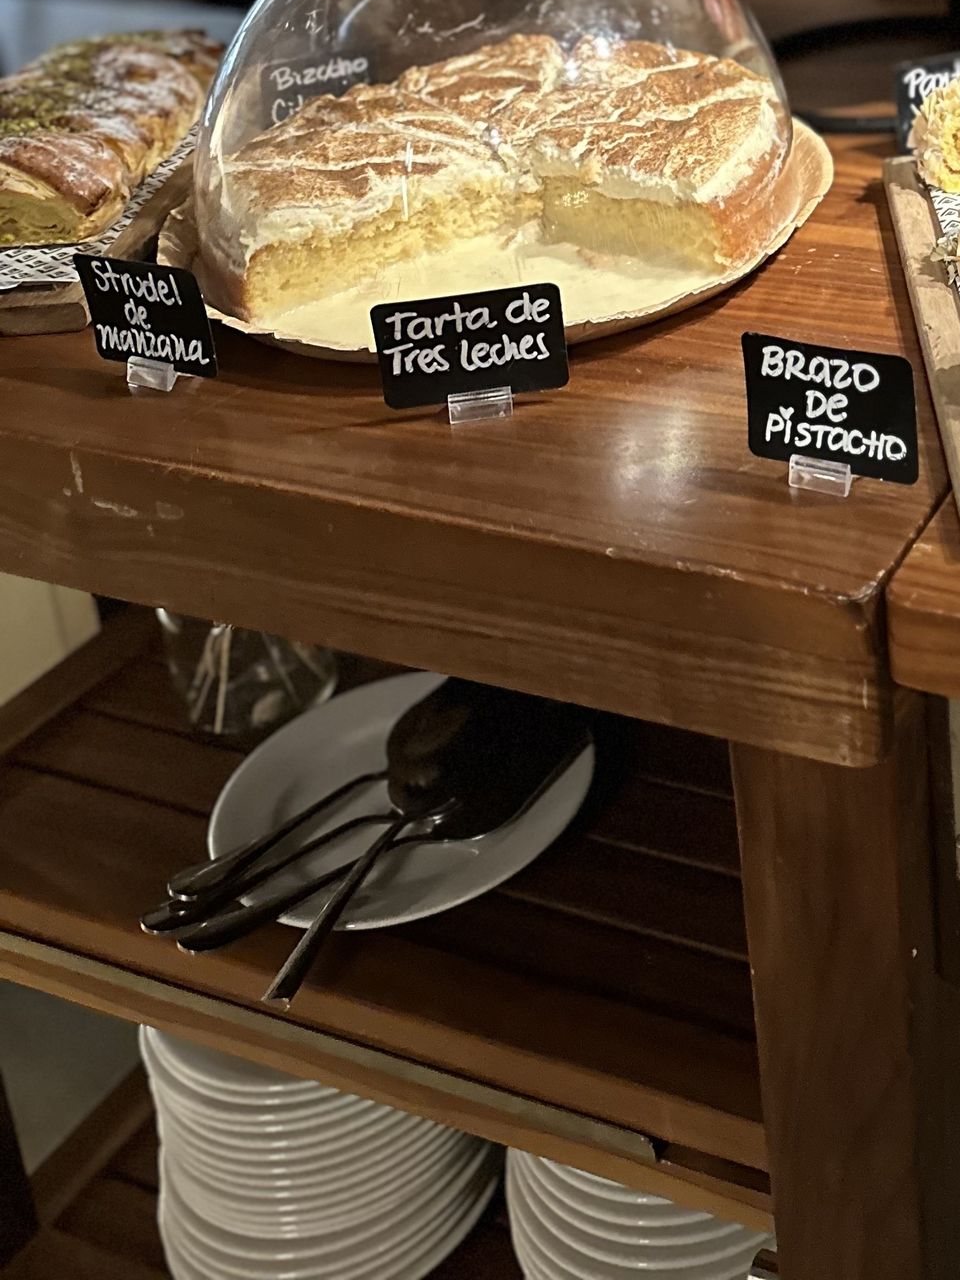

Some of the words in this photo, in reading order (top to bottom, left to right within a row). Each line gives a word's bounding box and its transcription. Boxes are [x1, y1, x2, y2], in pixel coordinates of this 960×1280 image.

[91, 261, 183, 306] Strudel
[124, 298, 151, 330] de
[385, 302, 498, 341] Tarta
[505, 292, 550, 324] de
[383, 343, 450, 376] Tres
[460, 332, 550, 371] leches
